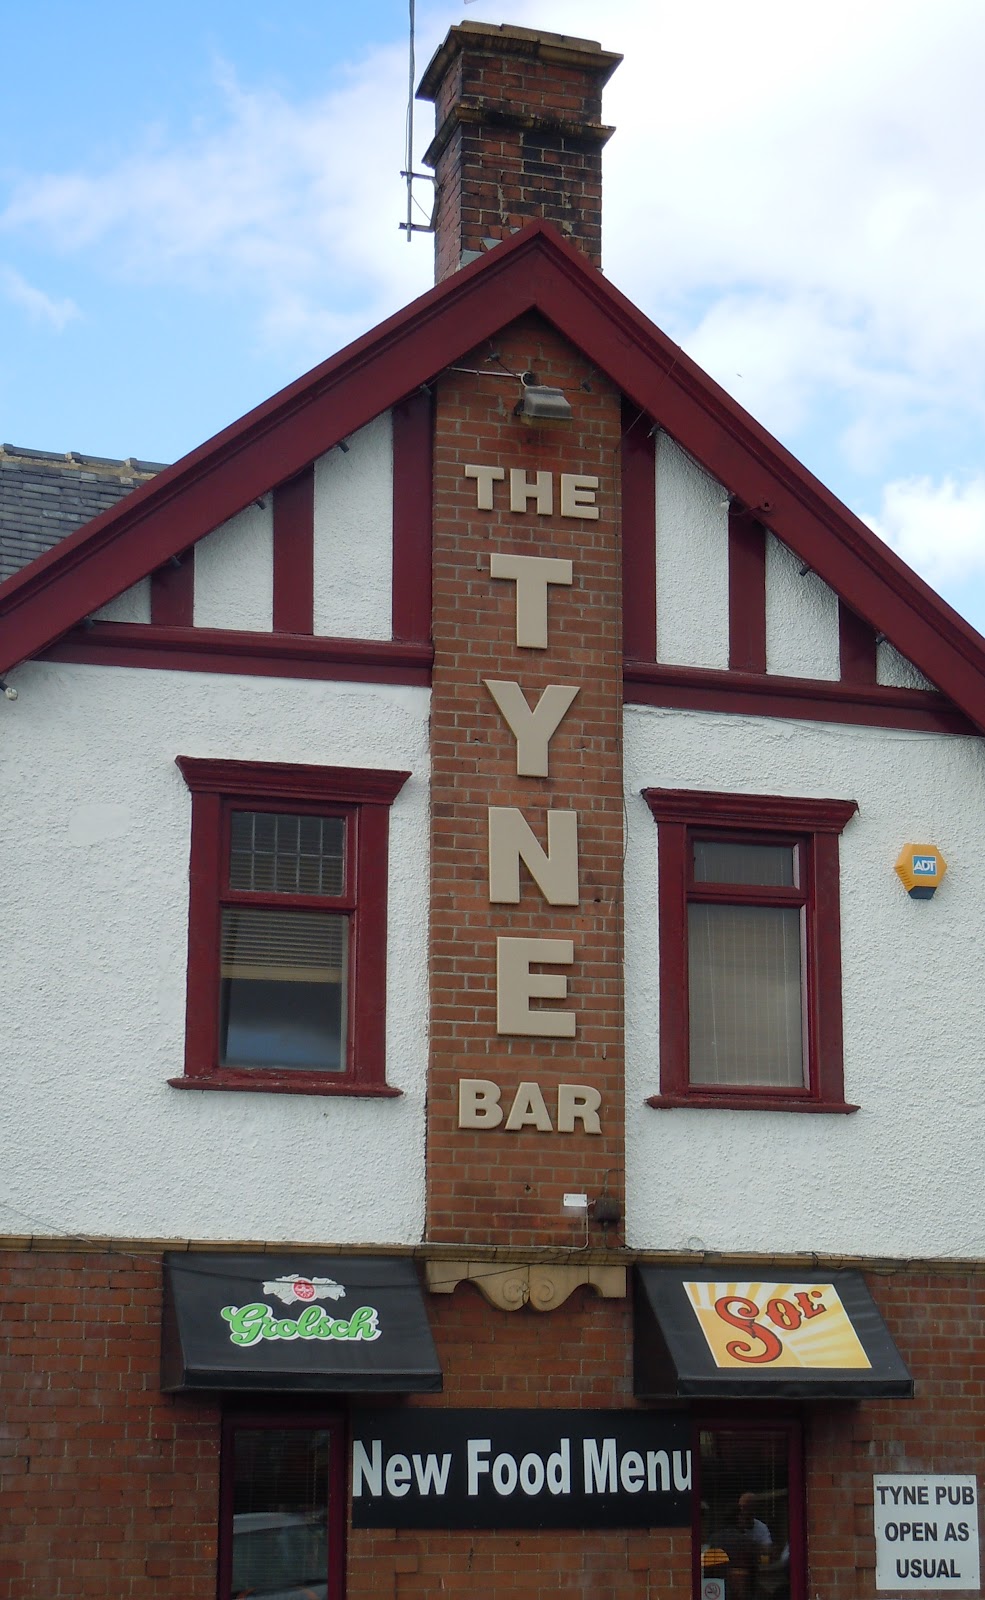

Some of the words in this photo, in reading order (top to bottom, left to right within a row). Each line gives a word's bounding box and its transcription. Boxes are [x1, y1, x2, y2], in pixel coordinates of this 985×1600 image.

[465, 464, 599, 520] THE
[481, 553, 581, 1039] TYNE
[913, 859, 937, 872] ADT
[458, 1078, 602, 1135] BAR
[220, 1303, 382, 1347] Grolsch
[353, 1439, 452, 1497] New
[467, 1438, 571, 1496] Food
[583, 1438, 692, 1494] Menu
[877, 1486, 929, 1505] TYNE
[935, 1486, 975, 1505] PUB
[884, 1522, 938, 1541] OPEN
[944, 1523, 970, 1541] AS
[896, 1559, 961, 1578] USUAL
